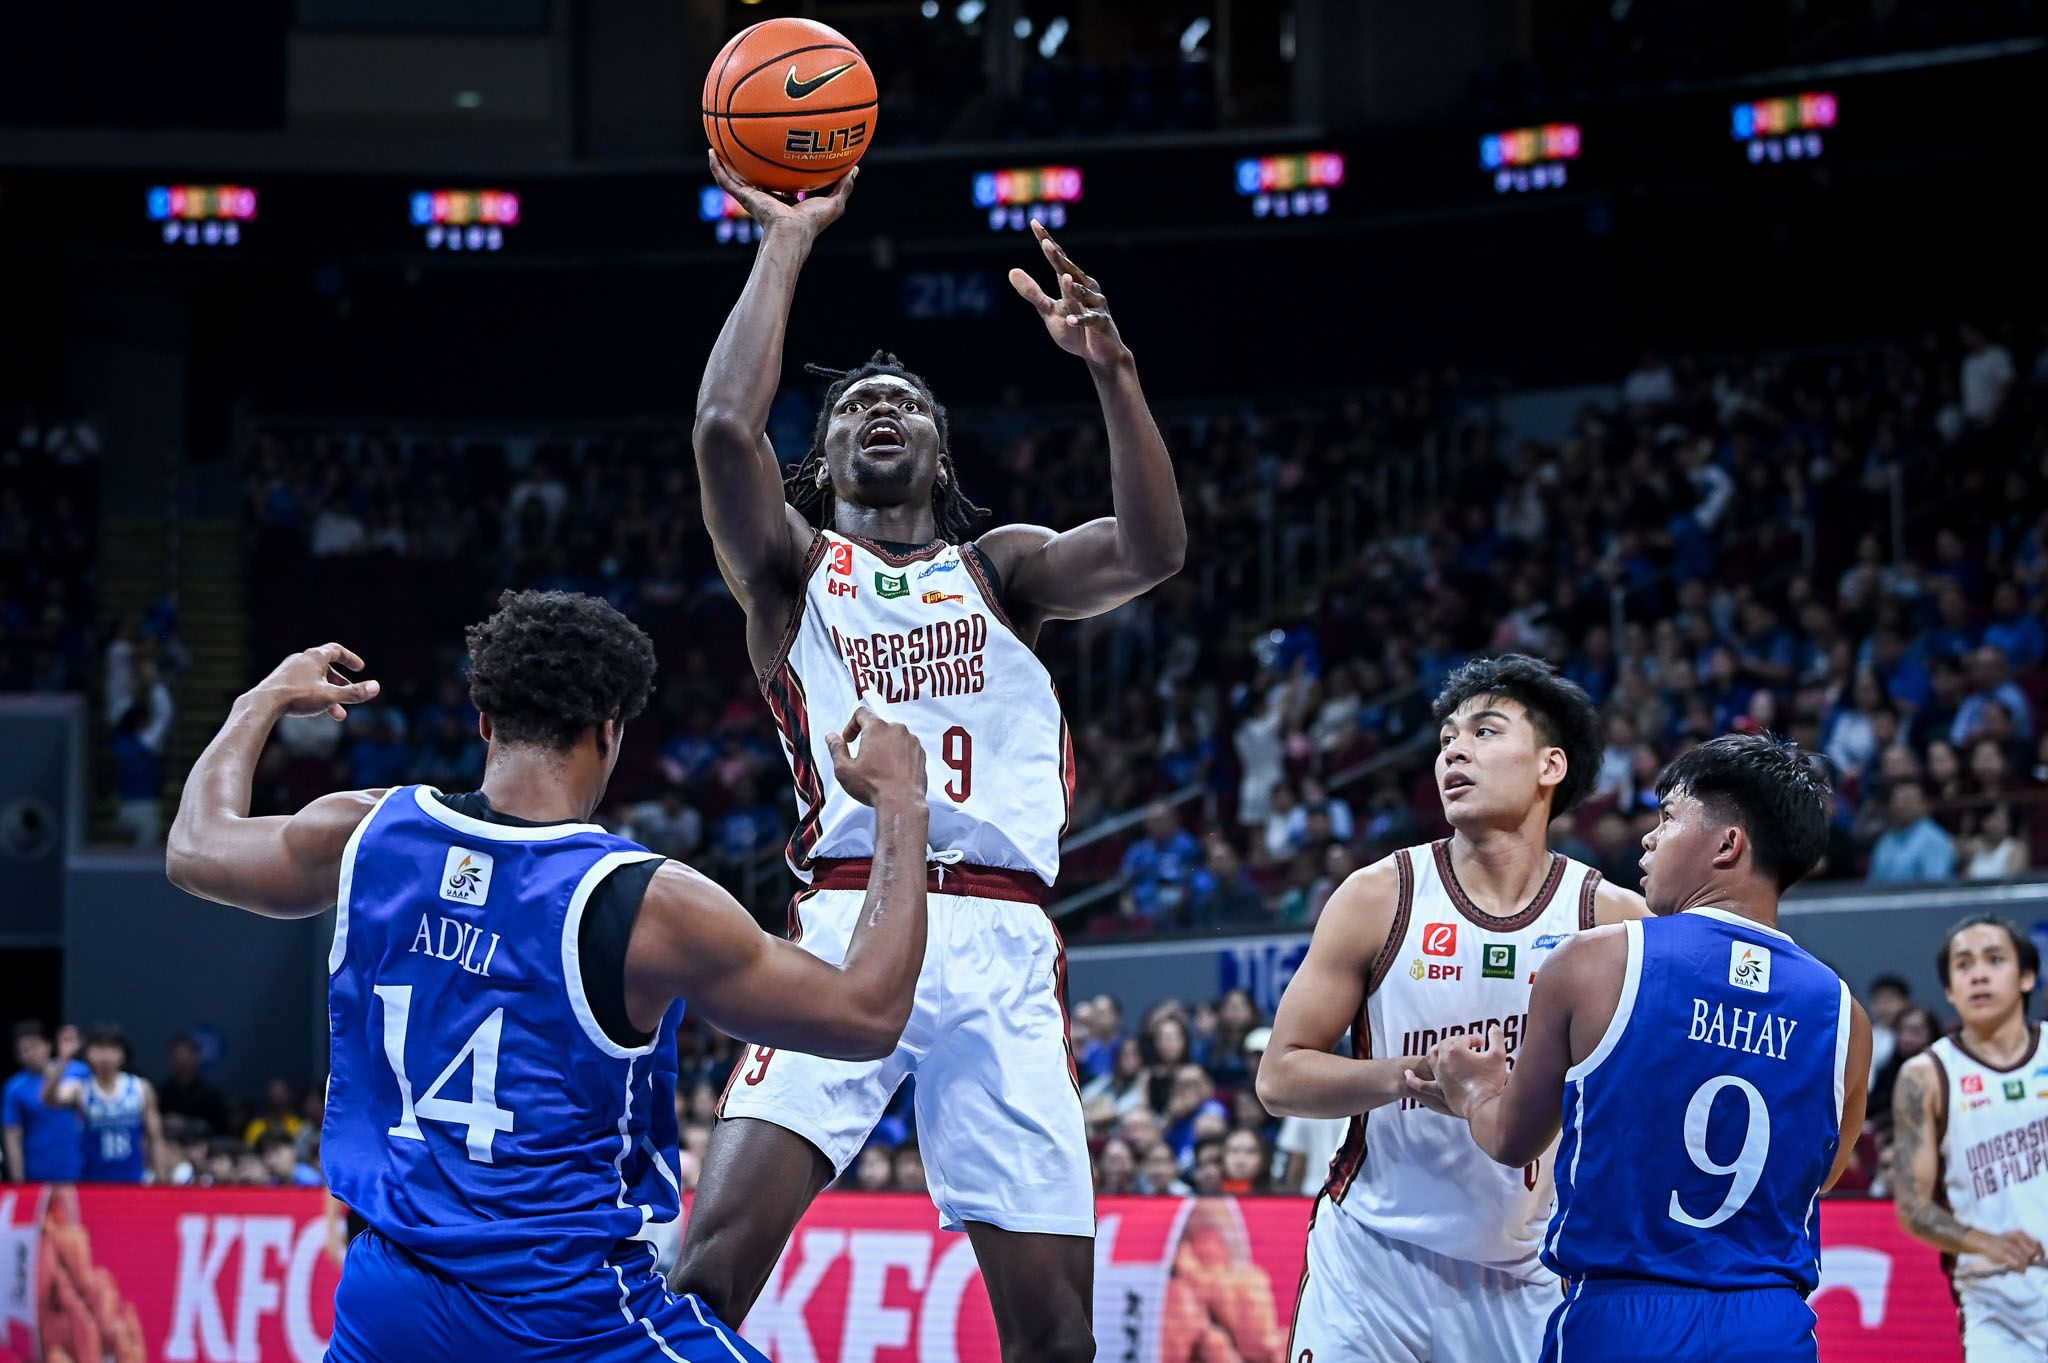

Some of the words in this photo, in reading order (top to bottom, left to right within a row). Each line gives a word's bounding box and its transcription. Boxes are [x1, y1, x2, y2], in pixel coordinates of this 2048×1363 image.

[785, 121, 867, 152] ELITE
[828, 578, 858, 599] BPI
[831, 613, 987, 670] BERSIDAD
[942, 726, 972, 803] 9
[409, 913, 500, 977] ADILI
[1428, 964, 1463, 981] BPI
[1688, 998, 1797, 1060] BAHAY
[373, 984, 514, 1164] 14
[745, 1046, 776, 1086] 9
[1669, 1075, 1770, 1228] 9
[1965, 1115, 2048, 1172] UNIBERSI
[1972, 1166, 1998, 1200] NG
